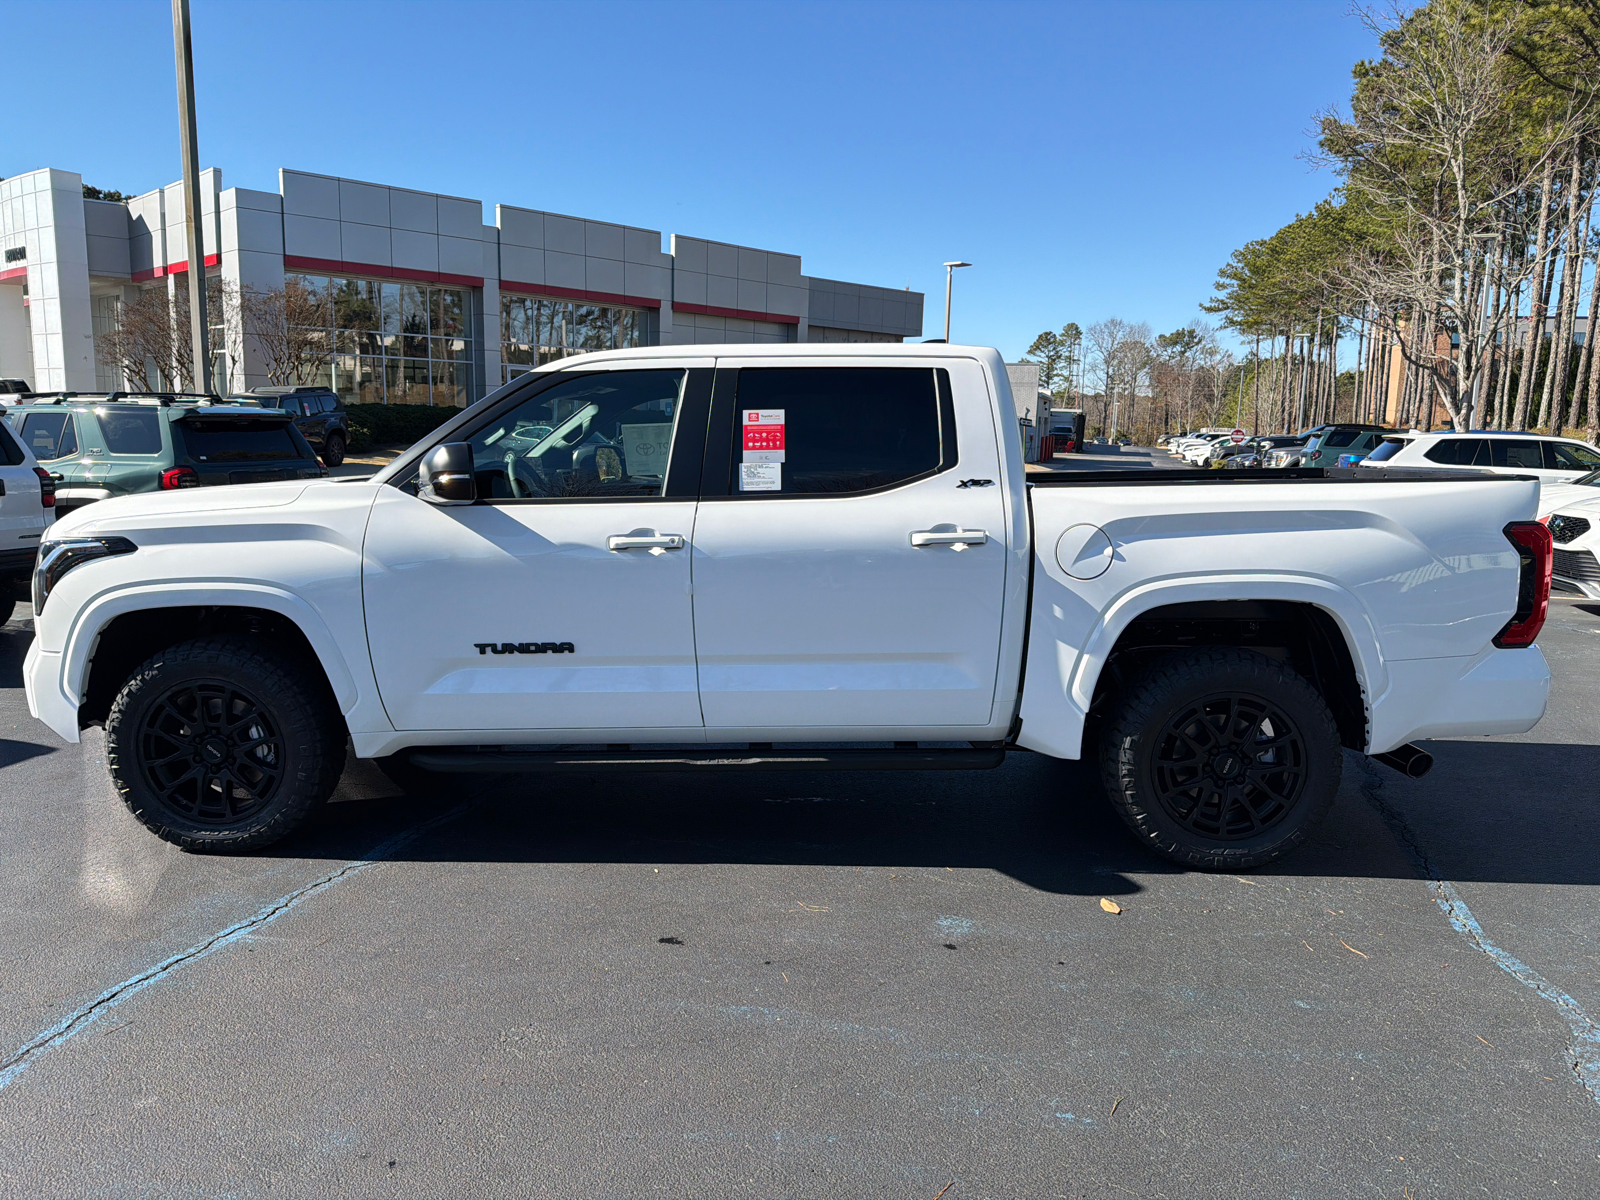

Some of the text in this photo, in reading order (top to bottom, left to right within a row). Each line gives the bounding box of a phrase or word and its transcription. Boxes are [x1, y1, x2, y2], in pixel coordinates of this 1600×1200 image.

[473, 642, 575, 655] TUNDRA
[206, 745, 221, 758] TOYOTA
[1222, 758, 1233, 774] TOYOTA
